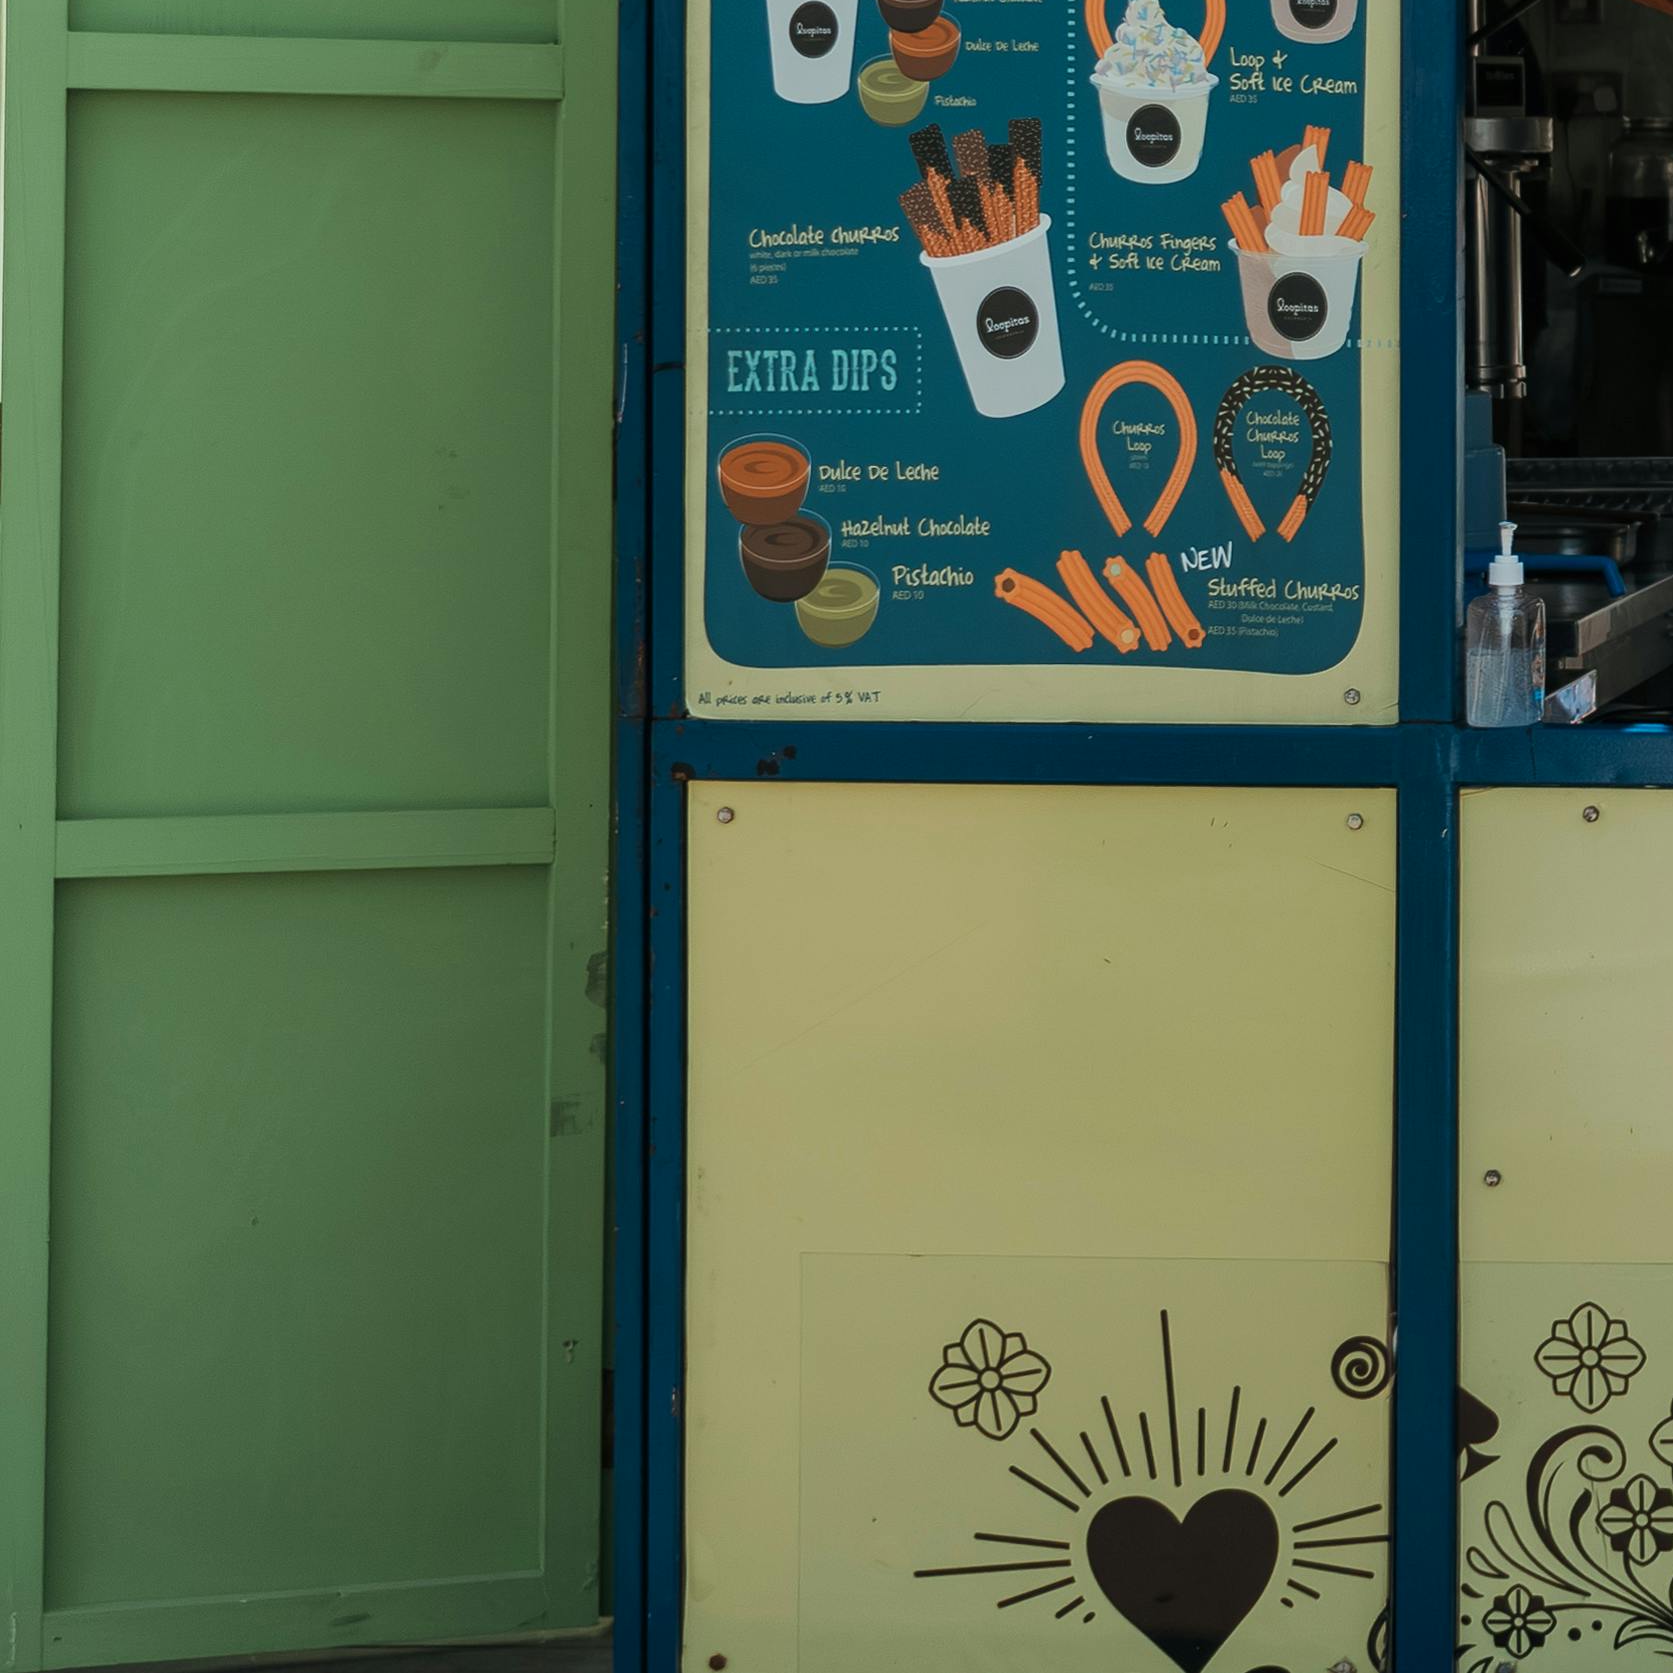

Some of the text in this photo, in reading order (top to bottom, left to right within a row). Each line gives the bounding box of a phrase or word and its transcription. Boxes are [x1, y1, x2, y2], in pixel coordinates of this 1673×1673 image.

[1231, 47, 1264, 73] Loop
[1230, 70, 1265, 90] Soft
[1301, 75, 1357, 94] Cream
[750, 224, 823, 247] Chocolate
[1090, 232, 1216, 258] Churros Fingers
[1109, 253, 1139, 268] Soft
[1171, 253, 1220, 271] Cream
[986, 317, 1029, 332] loopitas
[728, 349, 896, 392] EXTRA DIPS
[1247, 410, 1299, 425] Chocolate
[1127, 434, 1151, 454] Loop
[1261, 441, 1285, 462] Loop
[819, 460, 938, 480] Dulce De Leche
[841, 515, 990, 536] Hazelnut Chocolate
[1181, 541, 1232, 572] NEW
[892, 564, 973, 586] Pistachio
[1208, 578, 1359, 601] Stuffed Churros
[699, 692, 711, 704] All
[716, 696, 747, 706] prices
[821, 692, 832, 703] of
[858, 691, 880, 702] VAT
